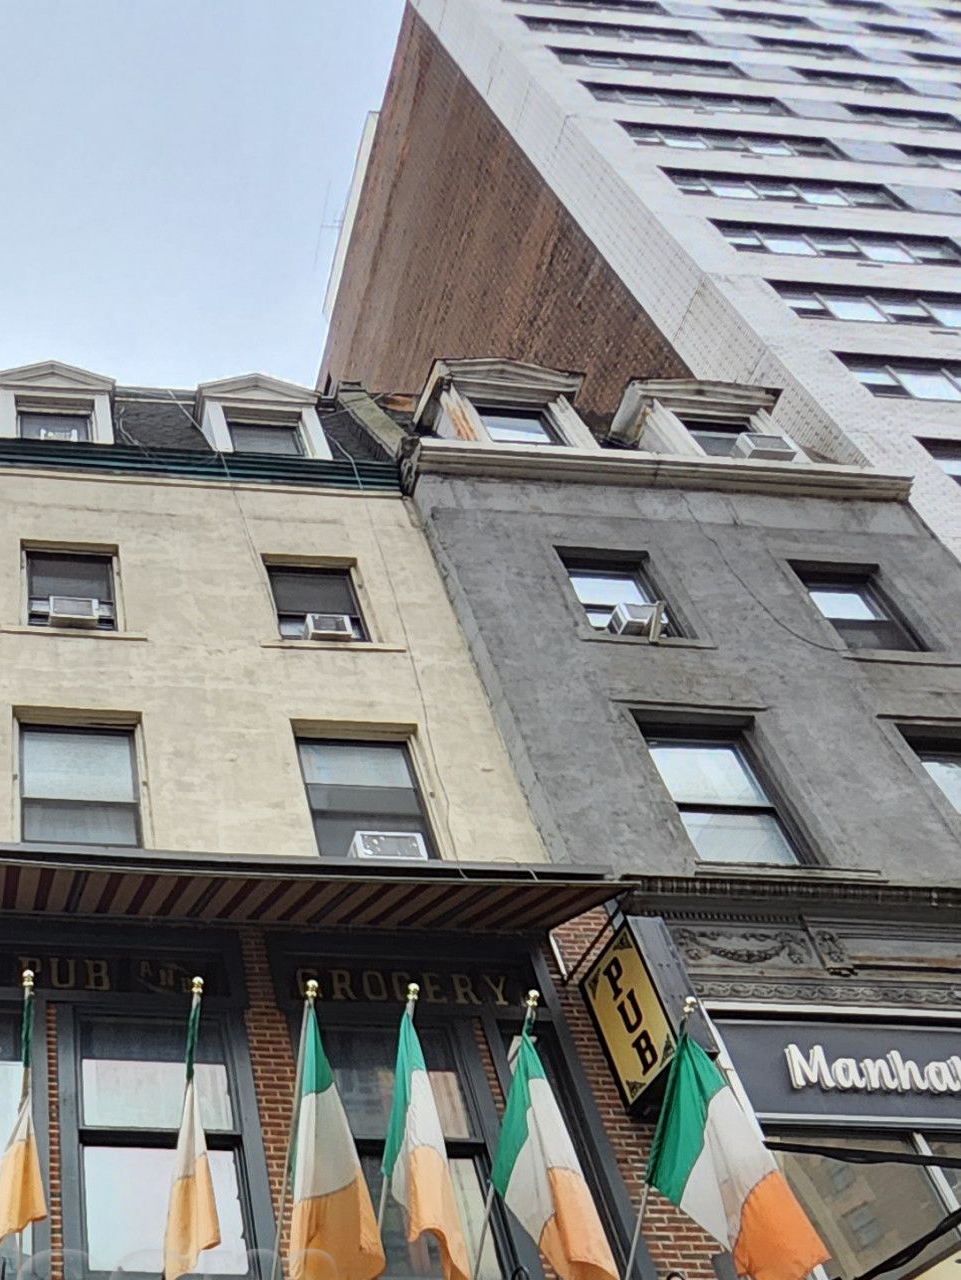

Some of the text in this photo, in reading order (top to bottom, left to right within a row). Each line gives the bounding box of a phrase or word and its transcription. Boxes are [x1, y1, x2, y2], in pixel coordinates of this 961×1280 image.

[18, 956, 110, 991] PUB
[296, 967, 510, 1006] GROCERY
[602, 956, 658, 1077] PUB
